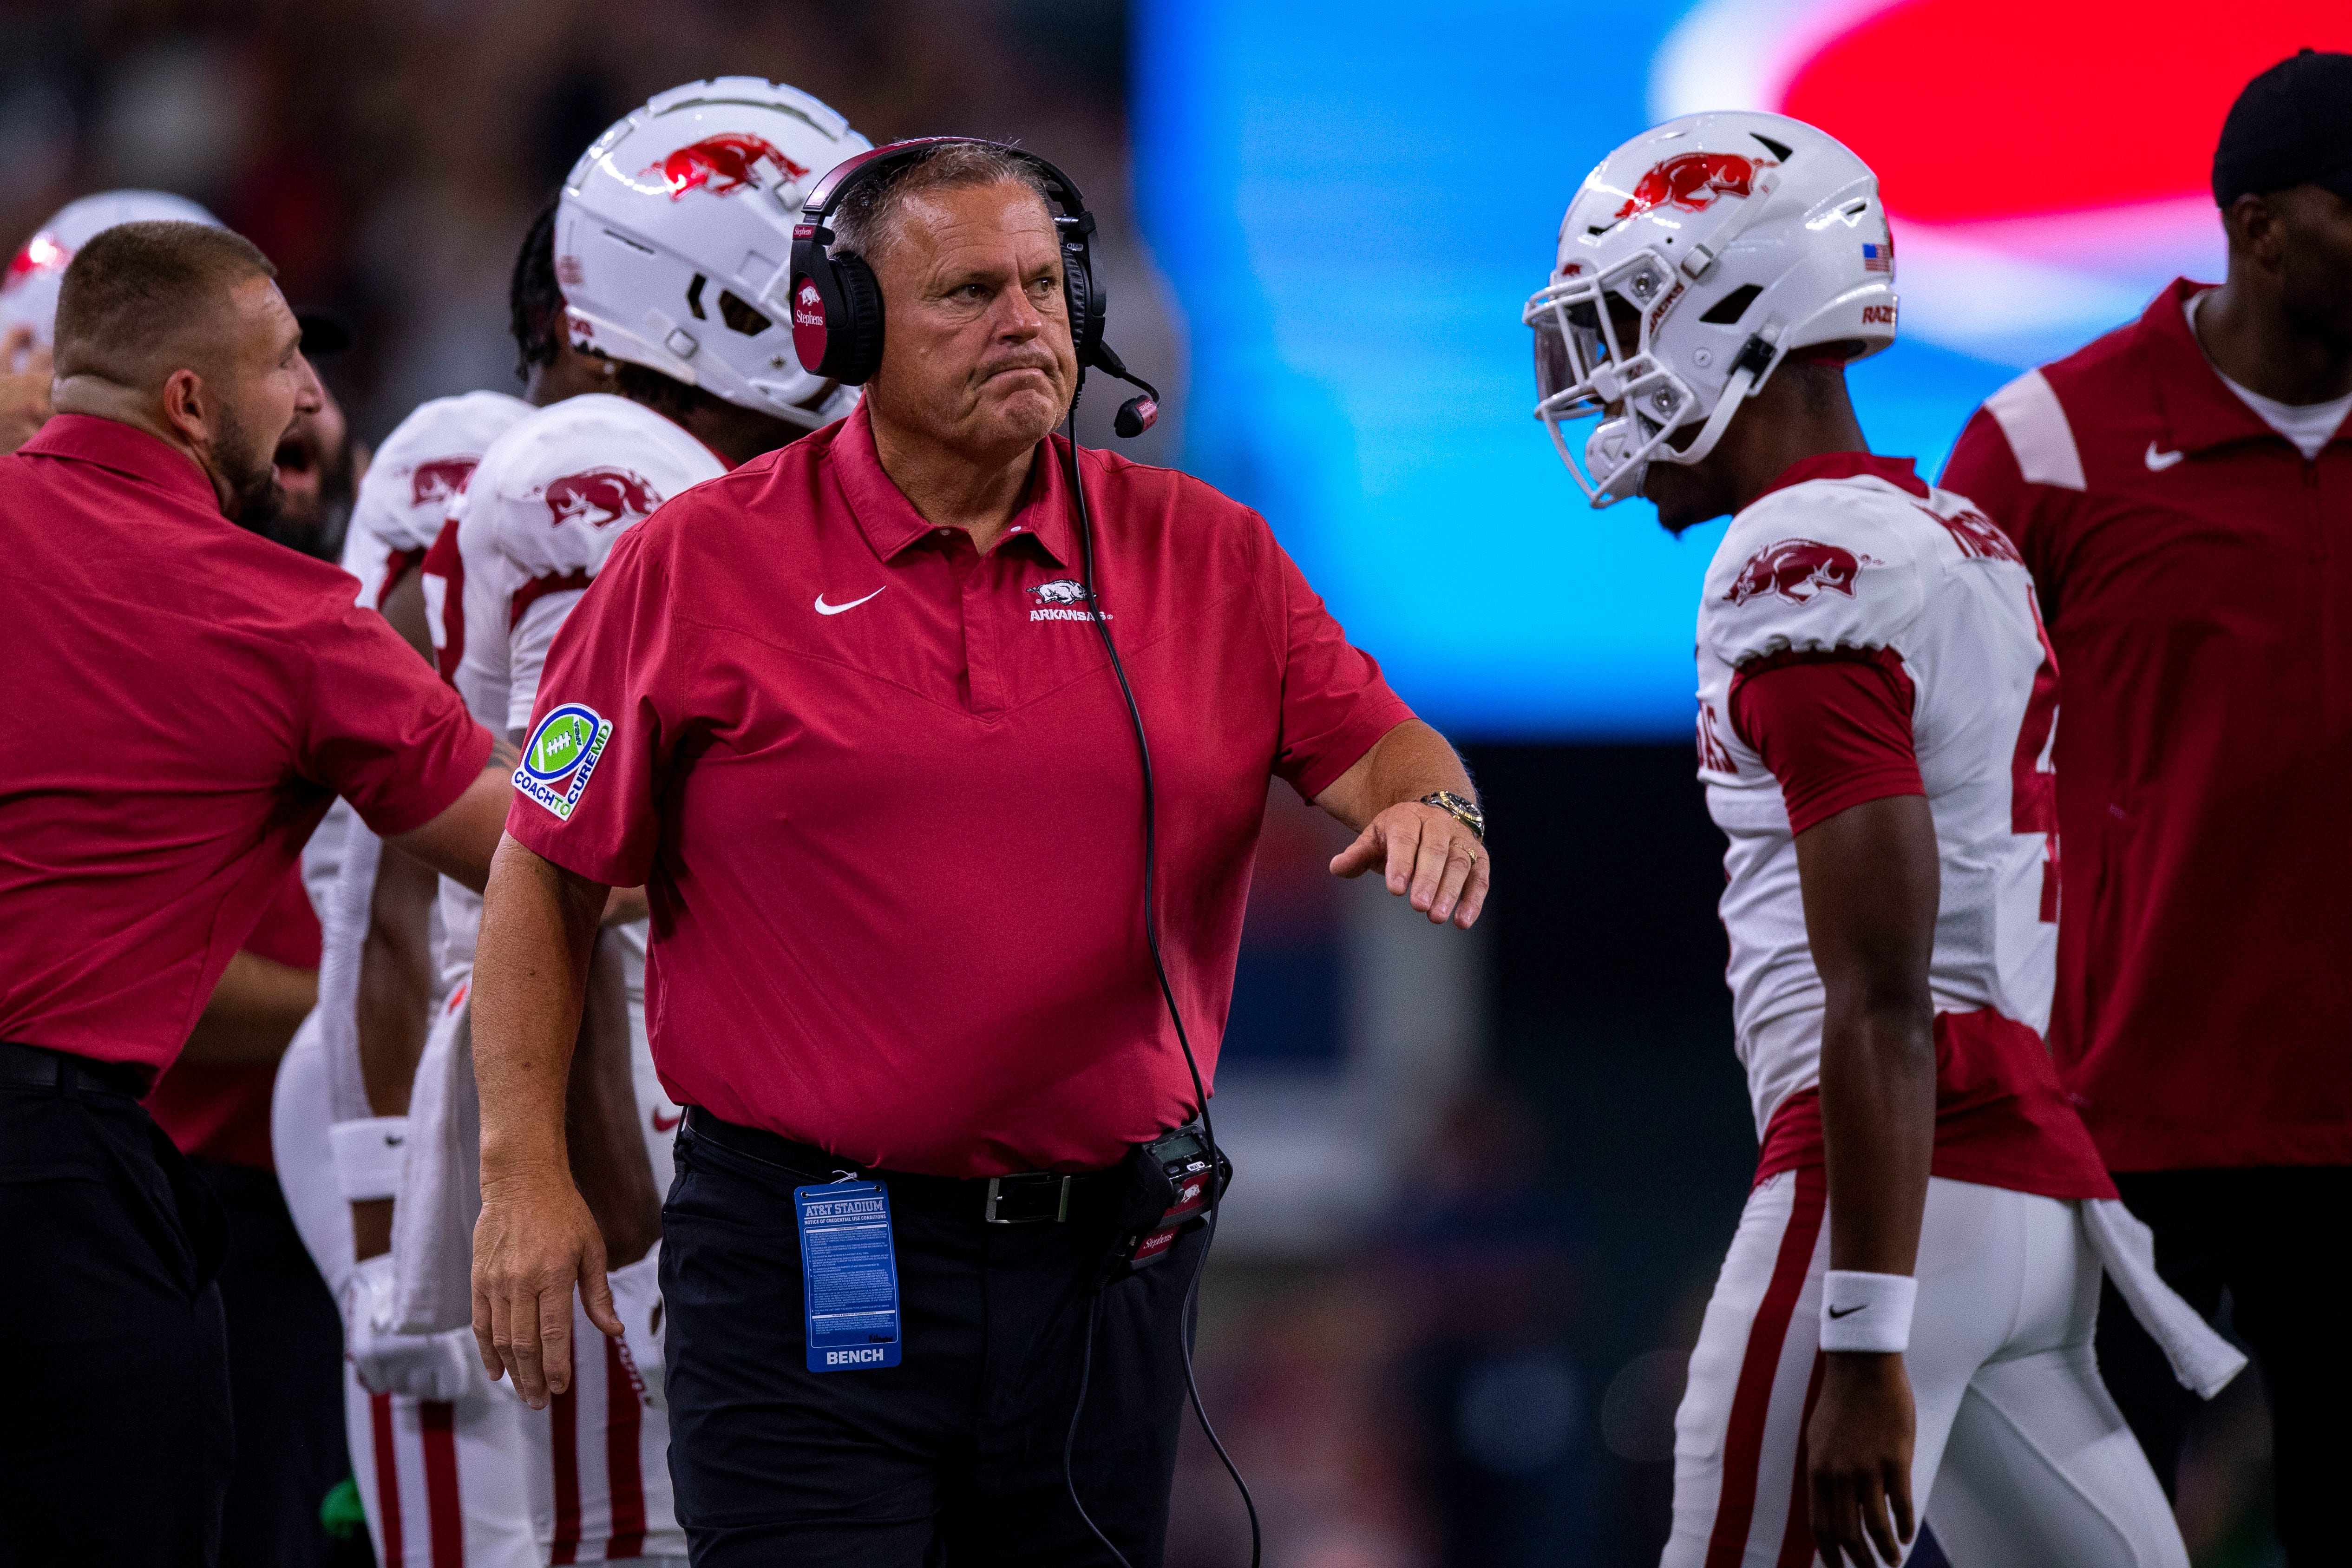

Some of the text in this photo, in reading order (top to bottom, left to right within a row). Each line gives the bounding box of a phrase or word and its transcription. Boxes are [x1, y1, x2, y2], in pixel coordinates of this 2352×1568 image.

[797, 309, 823, 327] Stephens
[1862, 305, 1894, 324] RAZ
[806, 1200, 883, 1216] AT&T STADIUM
[1143, 1233, 1173, 1248] Stephens
[826, 1348, 884, 1365] BENCH
